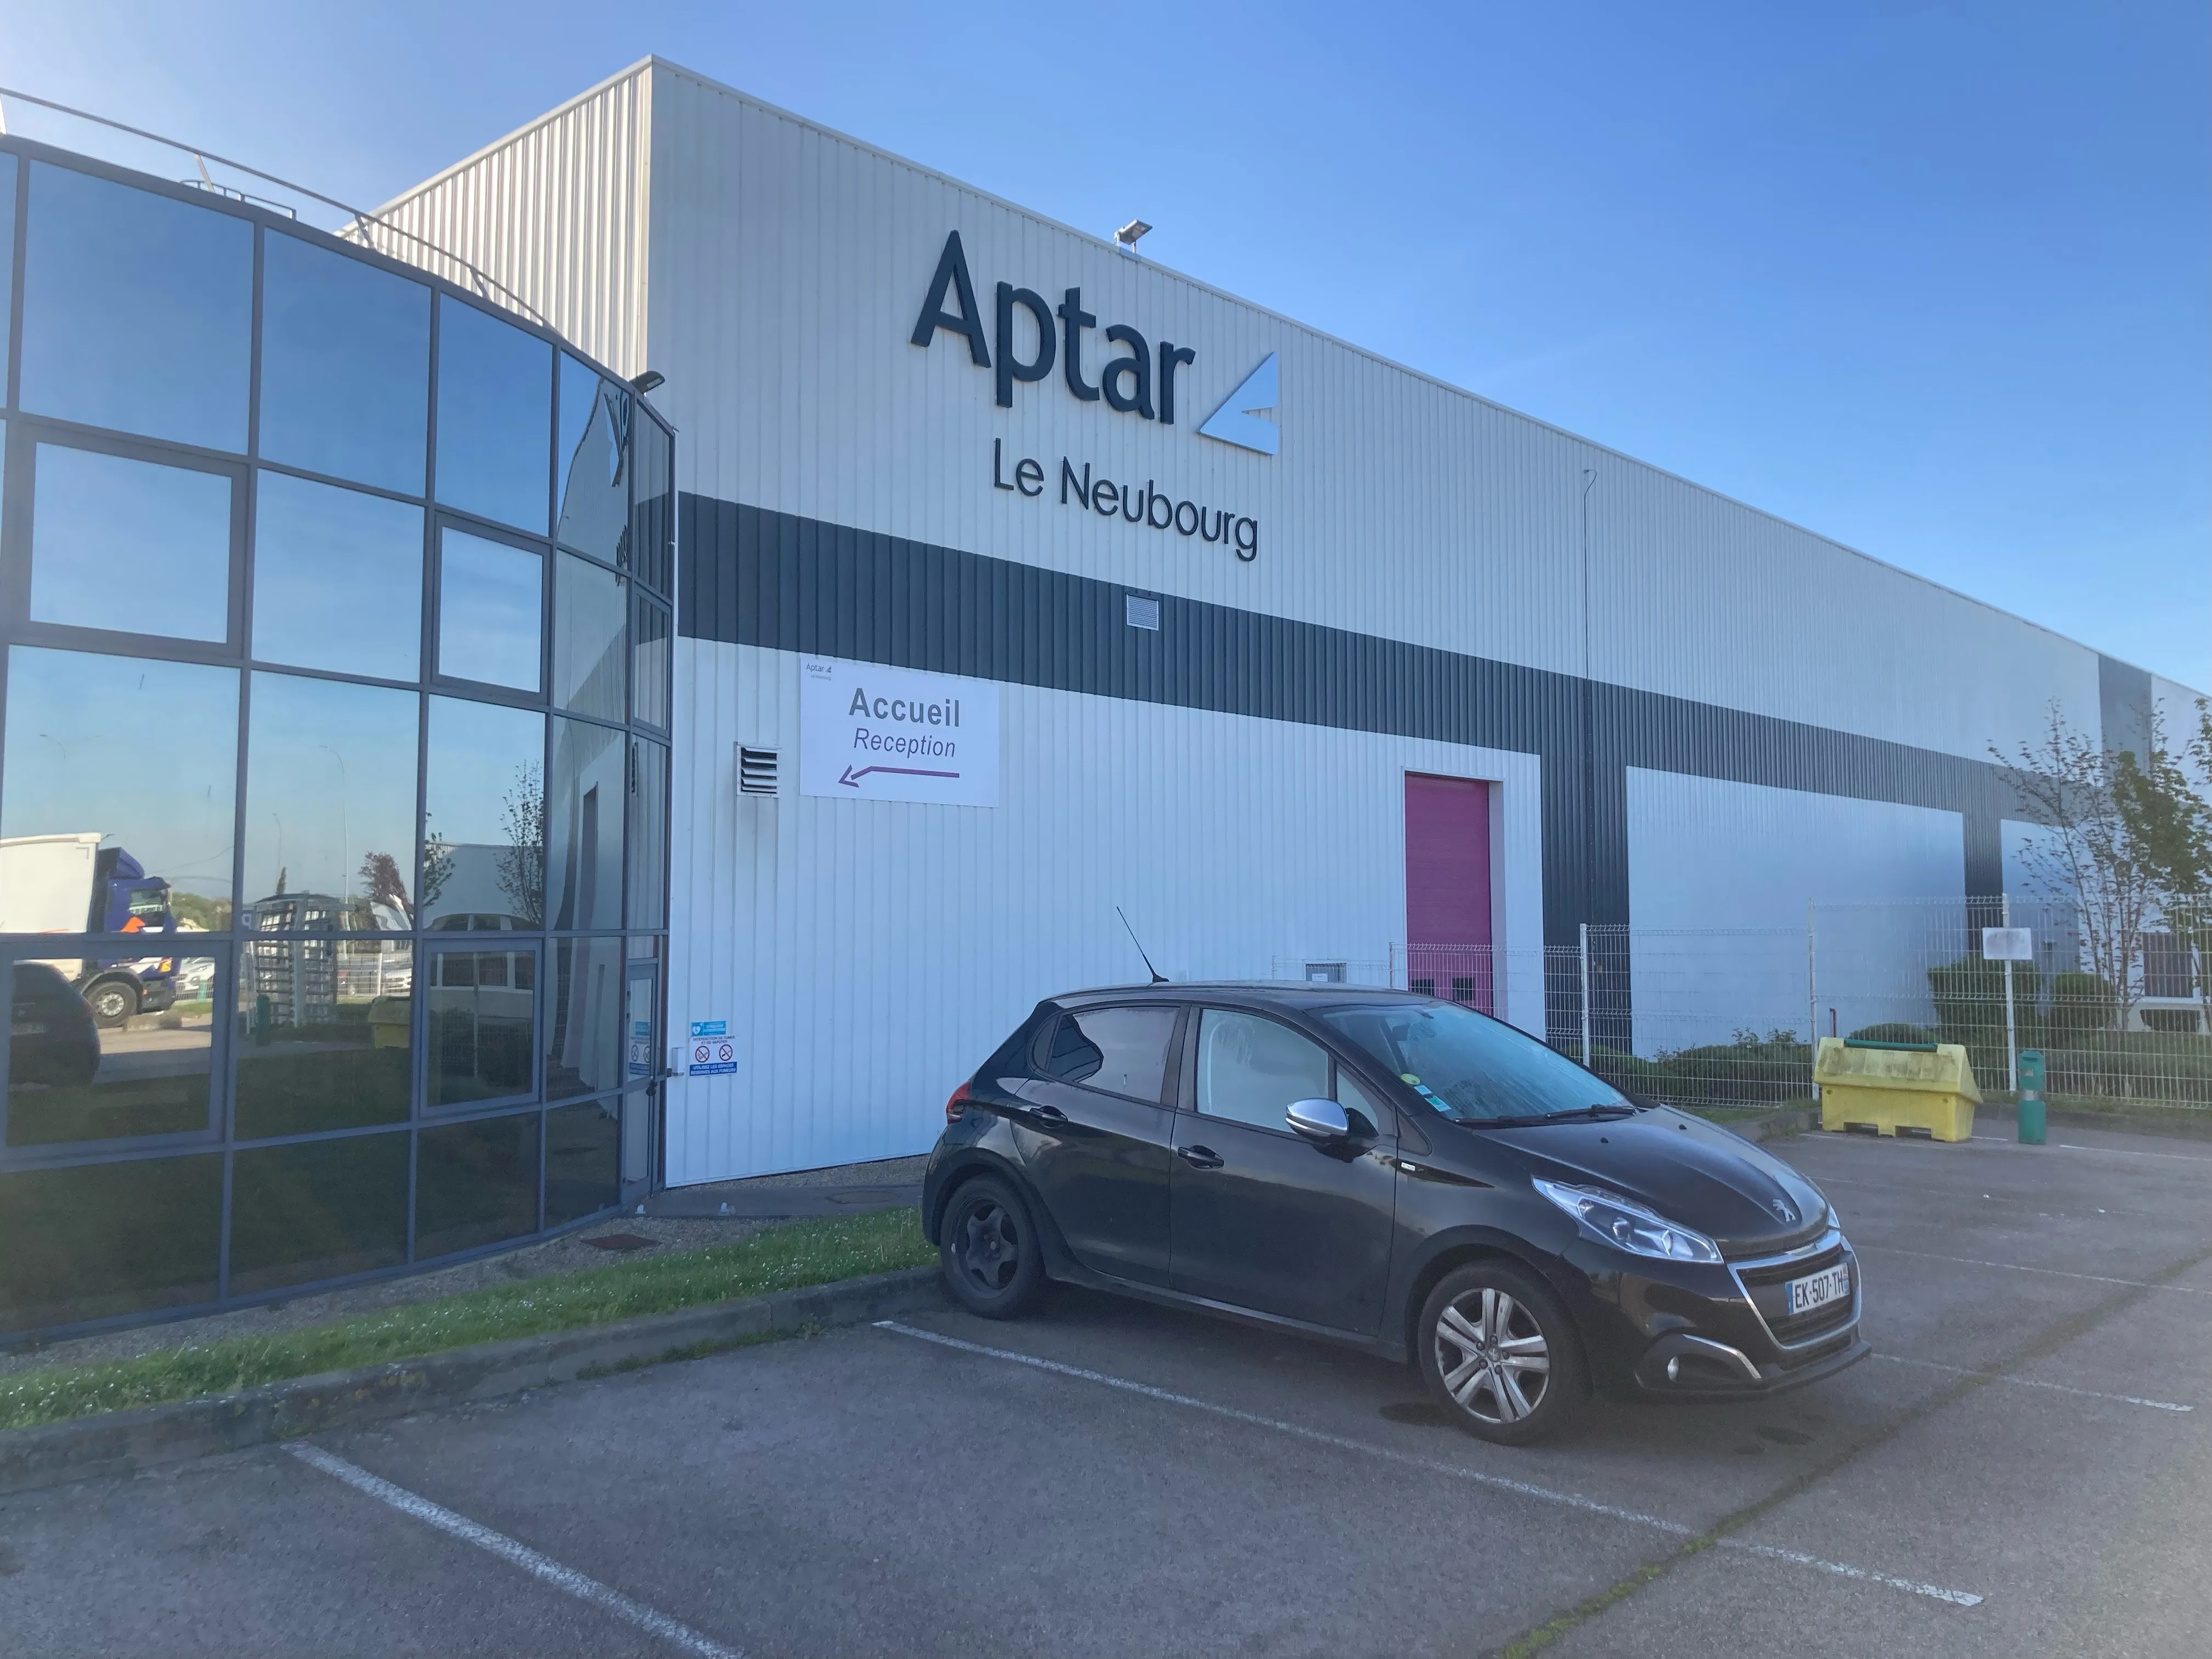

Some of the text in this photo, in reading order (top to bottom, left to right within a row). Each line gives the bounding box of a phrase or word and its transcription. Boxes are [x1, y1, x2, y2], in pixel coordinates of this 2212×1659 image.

[910, 229, 1196, 425] Aptar
[994, 438, 1258, 562] Le Neubourg
[806, 663, 825, 672] Aptar
[849, 687, 960, 727] Accueil
[854, 727, 956, 759] Reception
